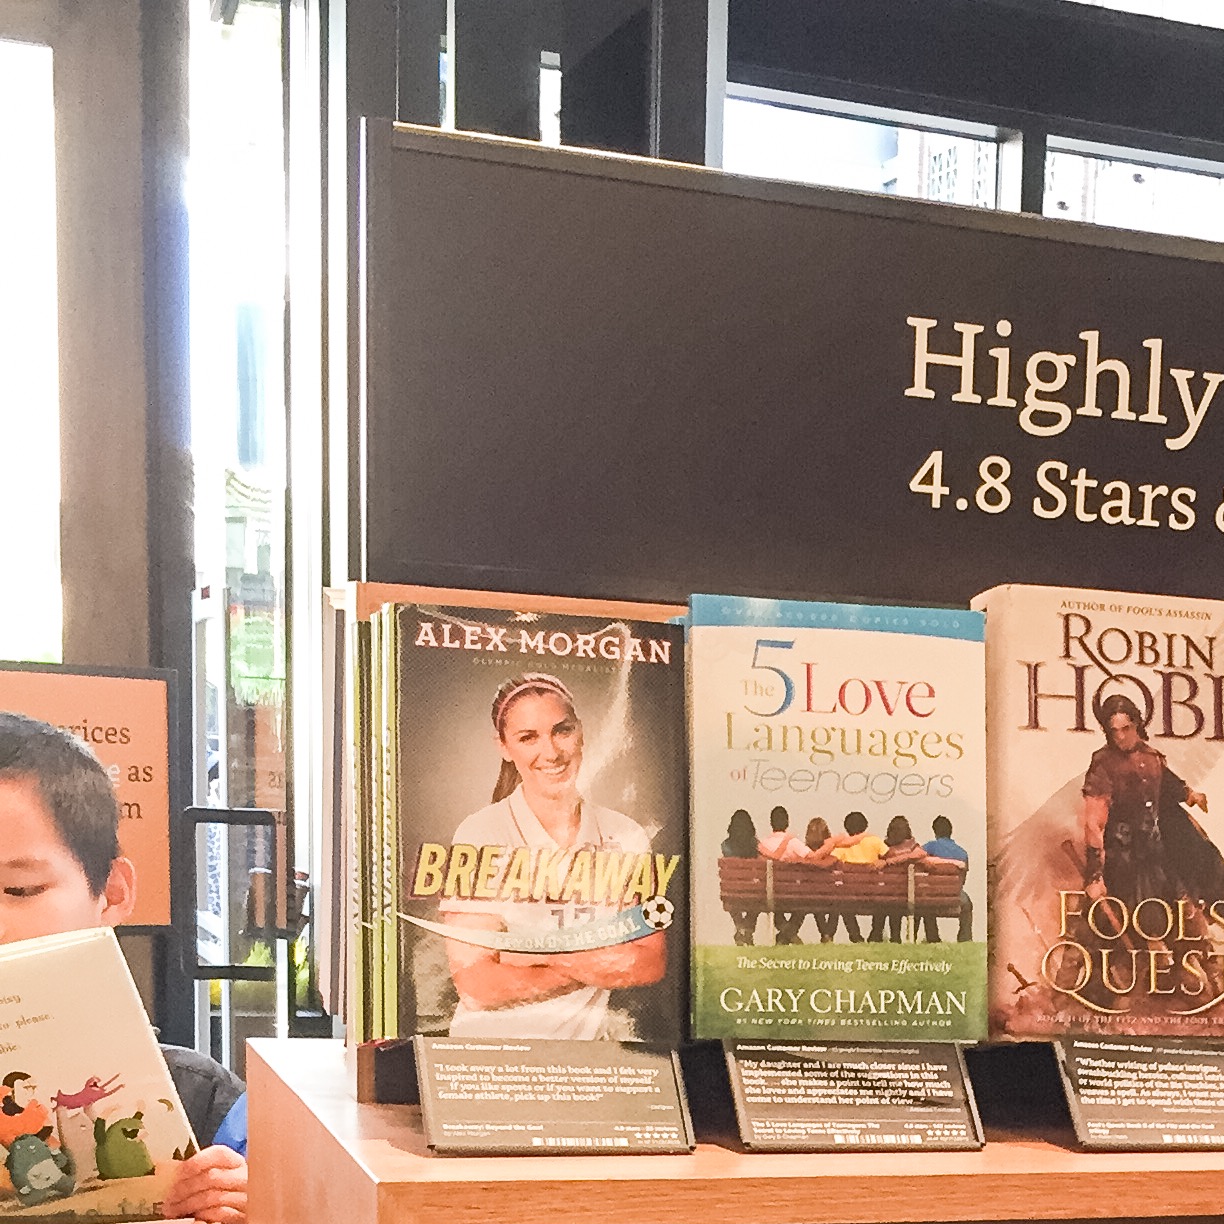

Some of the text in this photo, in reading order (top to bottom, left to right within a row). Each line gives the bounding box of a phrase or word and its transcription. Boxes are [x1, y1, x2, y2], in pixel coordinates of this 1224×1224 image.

[905, 317, 1224, 450] Highly
[910, 450, 1012, 513] 4.8
[1034, 461, 1196, 530] Stars
[1061, 601, 1212, 620] AUTHOR OF FOOL'S ASSASSIN
[415, 622, 671, 664] ALEX MORGAN
[1057, 612, 1216, 677] ROBIN
[740, 638, 936, 718] The 5 Love
[725, 712, 964, 768] Languages
[128, 765, 153, 782] as
[730, 759, 953, 803] of Teenagers
[411, 843, 680, 906] BREAKAWAY
[598, 918, 641, 940] GOAL
[736, 956, 952, 974] The Secret to Loving Teens Effectively
[719, 987, 966, 1015] GARY CHAPMAN
